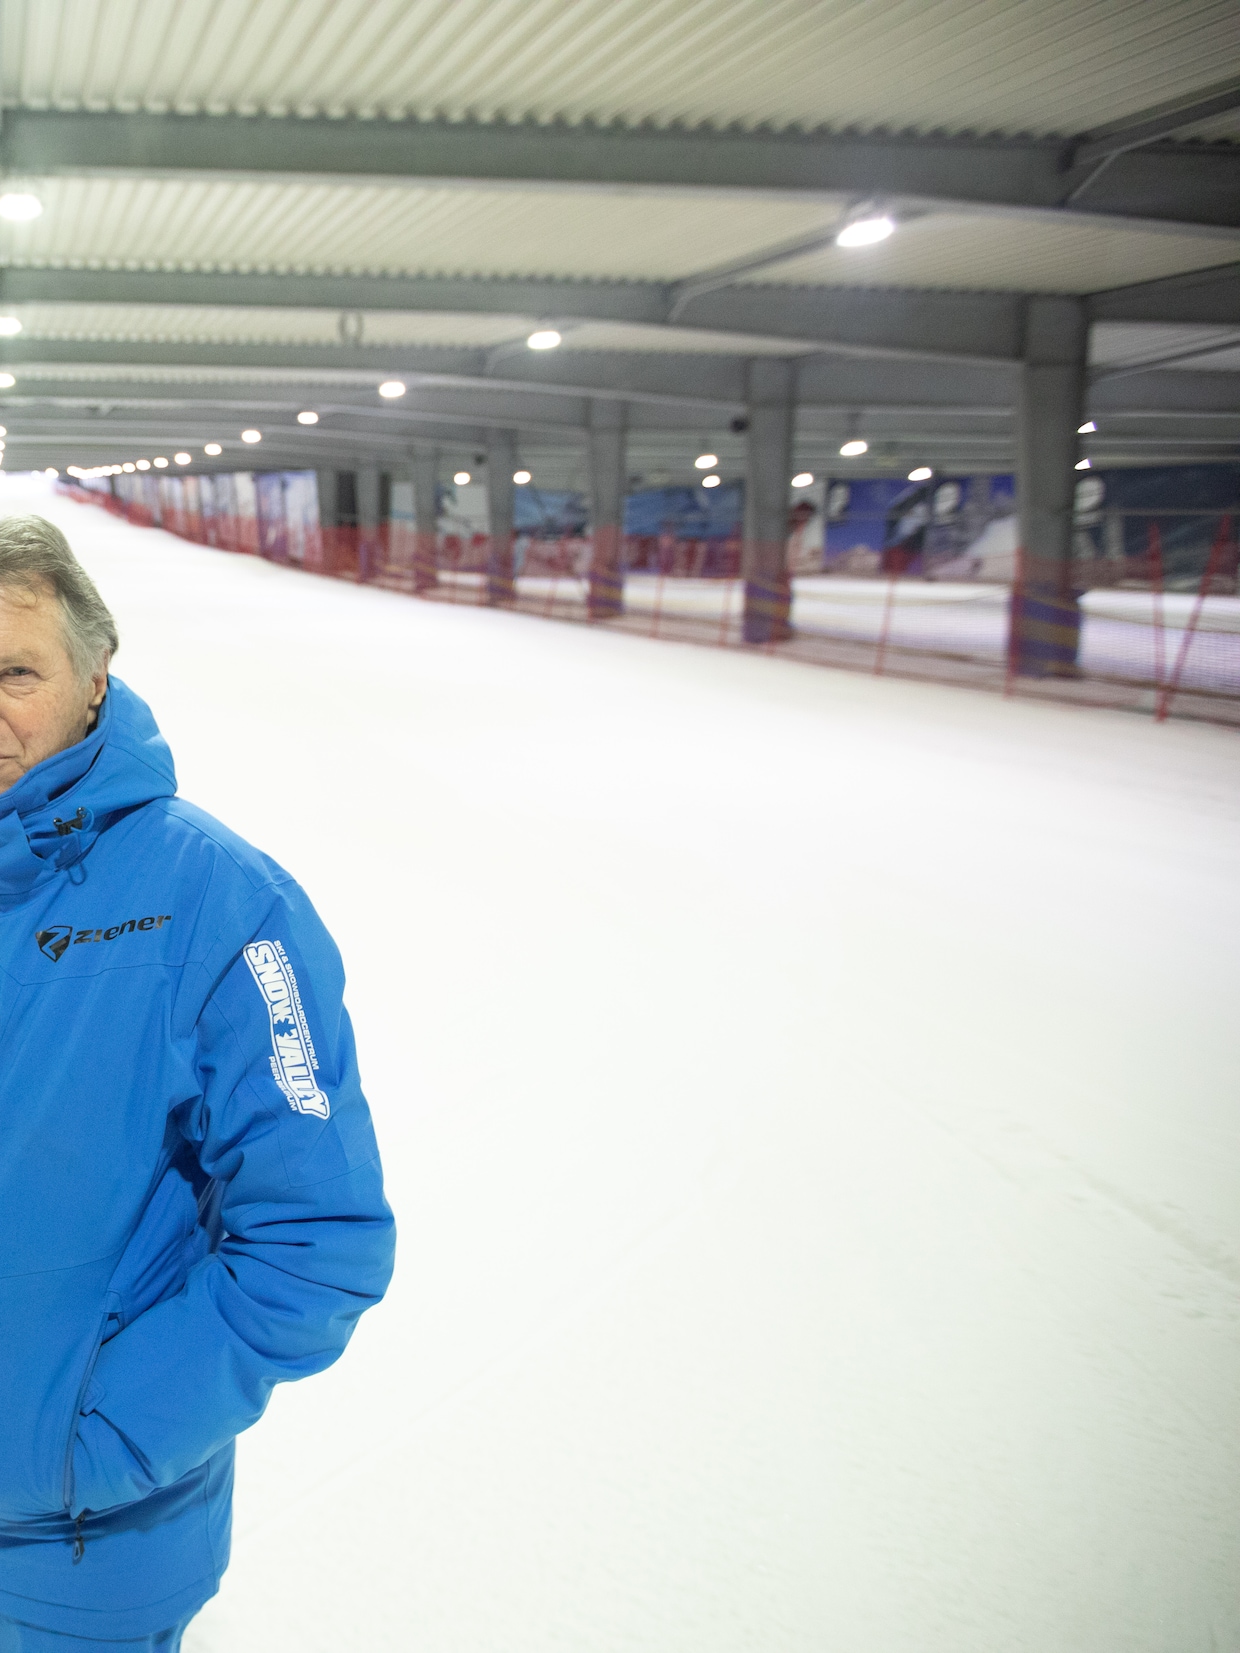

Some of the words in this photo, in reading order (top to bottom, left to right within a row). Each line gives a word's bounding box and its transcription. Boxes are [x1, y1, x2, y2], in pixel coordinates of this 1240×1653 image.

[73, 915, 172, 944] ziener
[273, 940, 285, 957] SKI
[281, 955, 290, 964] &
[246, 943, 296, 1025] SNOW
[285, 963, 319, 1070] SNOWBOARDCENTRUM
[268, 1055, 281, 1081] PEER
